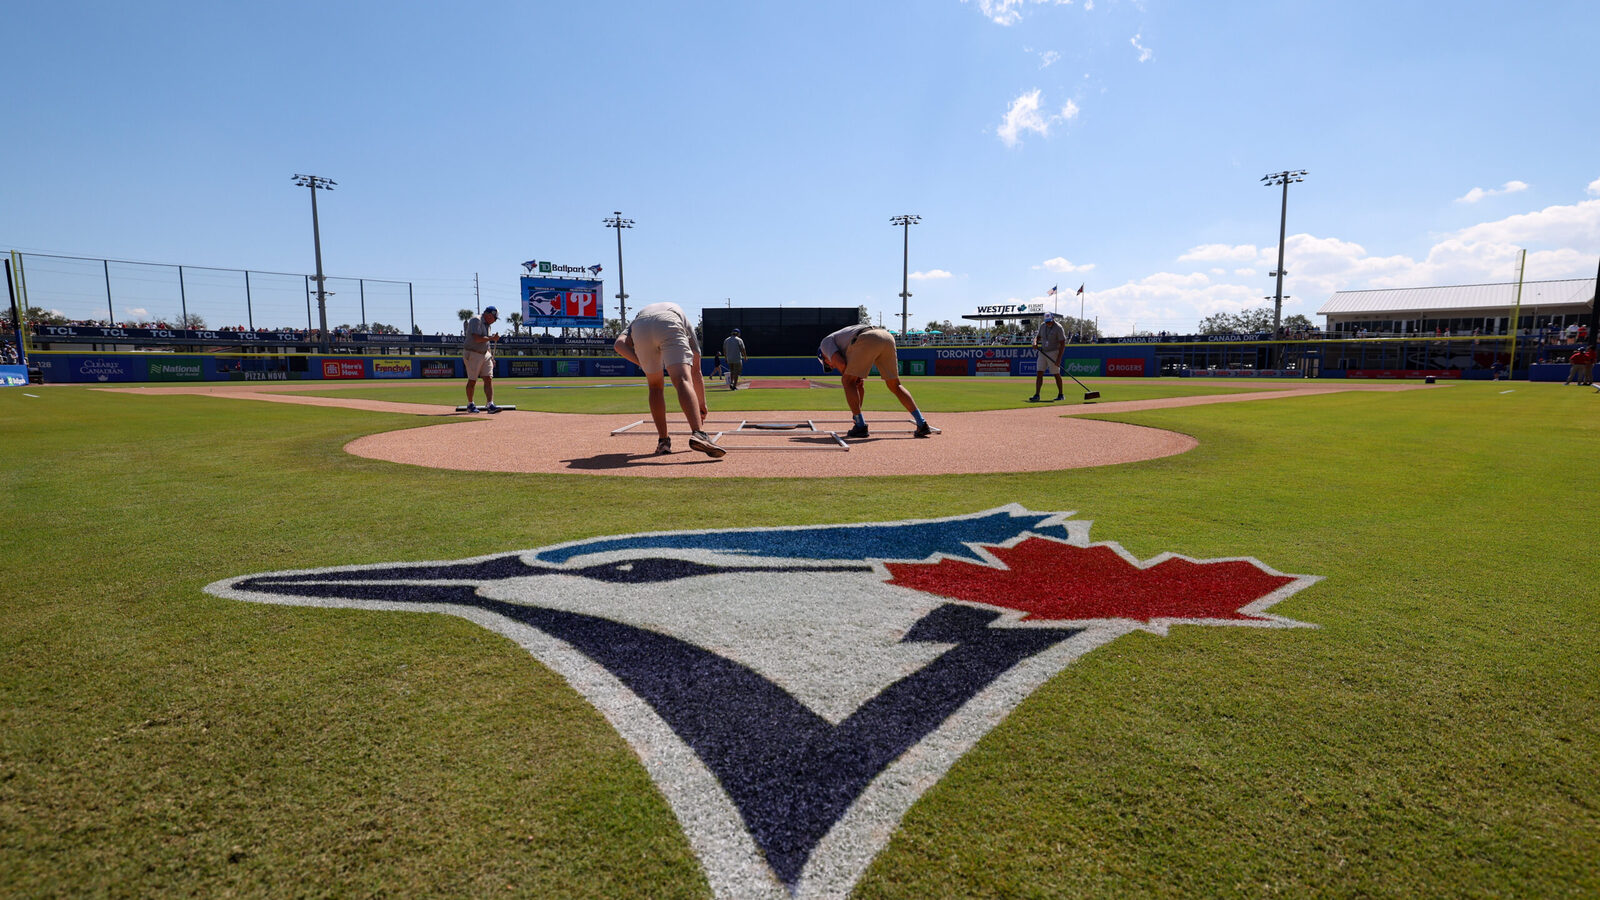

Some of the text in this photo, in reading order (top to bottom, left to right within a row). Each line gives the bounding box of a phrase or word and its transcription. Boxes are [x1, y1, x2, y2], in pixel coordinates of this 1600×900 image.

[552, 264, 586, 273] Ballpark
[570, 292, 592, 316] P
[978, 305, 1016, 314] WESTJET
[46, 327, 77, 335] TCL
[195, 331, 219, 339] TCL
[238, 332, 260, 340] TCL
[277, 333, 298, 341] TCL
[936, 349, 1038, 358] TORONTO BLUE JAY
[80, 367, 124, 375] CANADIAN
[162, 365, 200, 373] National
[376, 364, 411, 373] Frenchy's
[912, 363, 925, 372] TD
[245, 372, 287, 380] PIZZA NOVA
